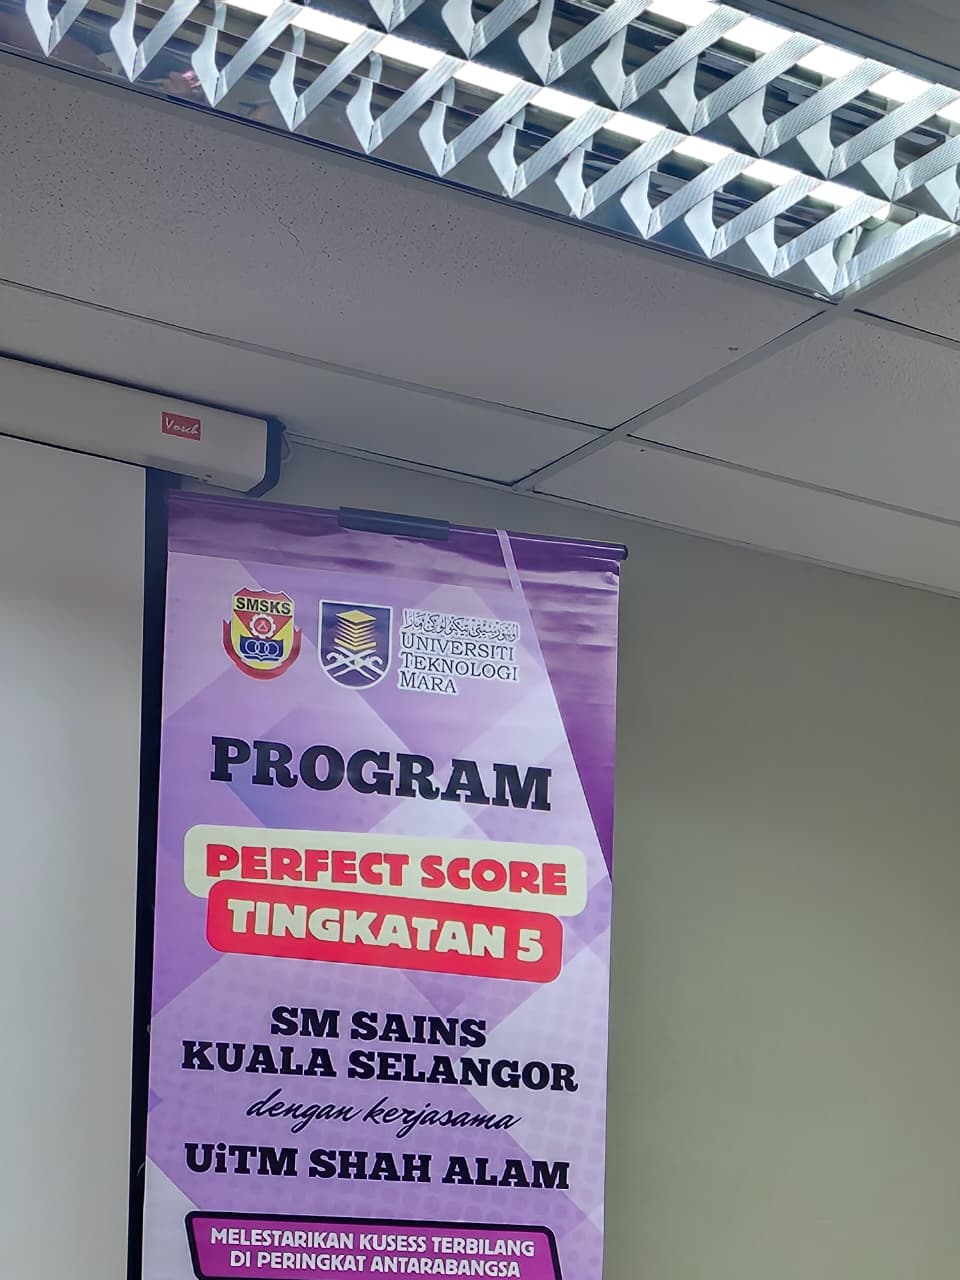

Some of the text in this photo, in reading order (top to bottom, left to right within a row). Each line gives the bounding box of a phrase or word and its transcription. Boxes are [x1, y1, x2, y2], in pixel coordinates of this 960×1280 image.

[236, 597, 291, 615] SMSKS
[401, 632, 514, 660] UNIVERSITI
[401, 652, 518, 680] TEKNOLOGI
[400, 671, 456, 693] MARA
[210, 735, 552, 811] PROGRAM
[206, 844, 568, 896] PERFECT SCORE
[227, 898, 543, 962] TINGKATAN 5
[271, 1006, 487, 1047] SM SAINS
[181, 1041, 578, 1092] KUALA SELANGOR
[246, 1088, 521, 1138] dengan kerjasama
[184, 1142, 569, 1189] UiTM SHAH ALAM
[210, 1227, 535, 1257] MELESTARIKAN KUSESS TERBILANG
[230, 1250, 520, 1278] DI PERINGKAT ANTARABANGSA
